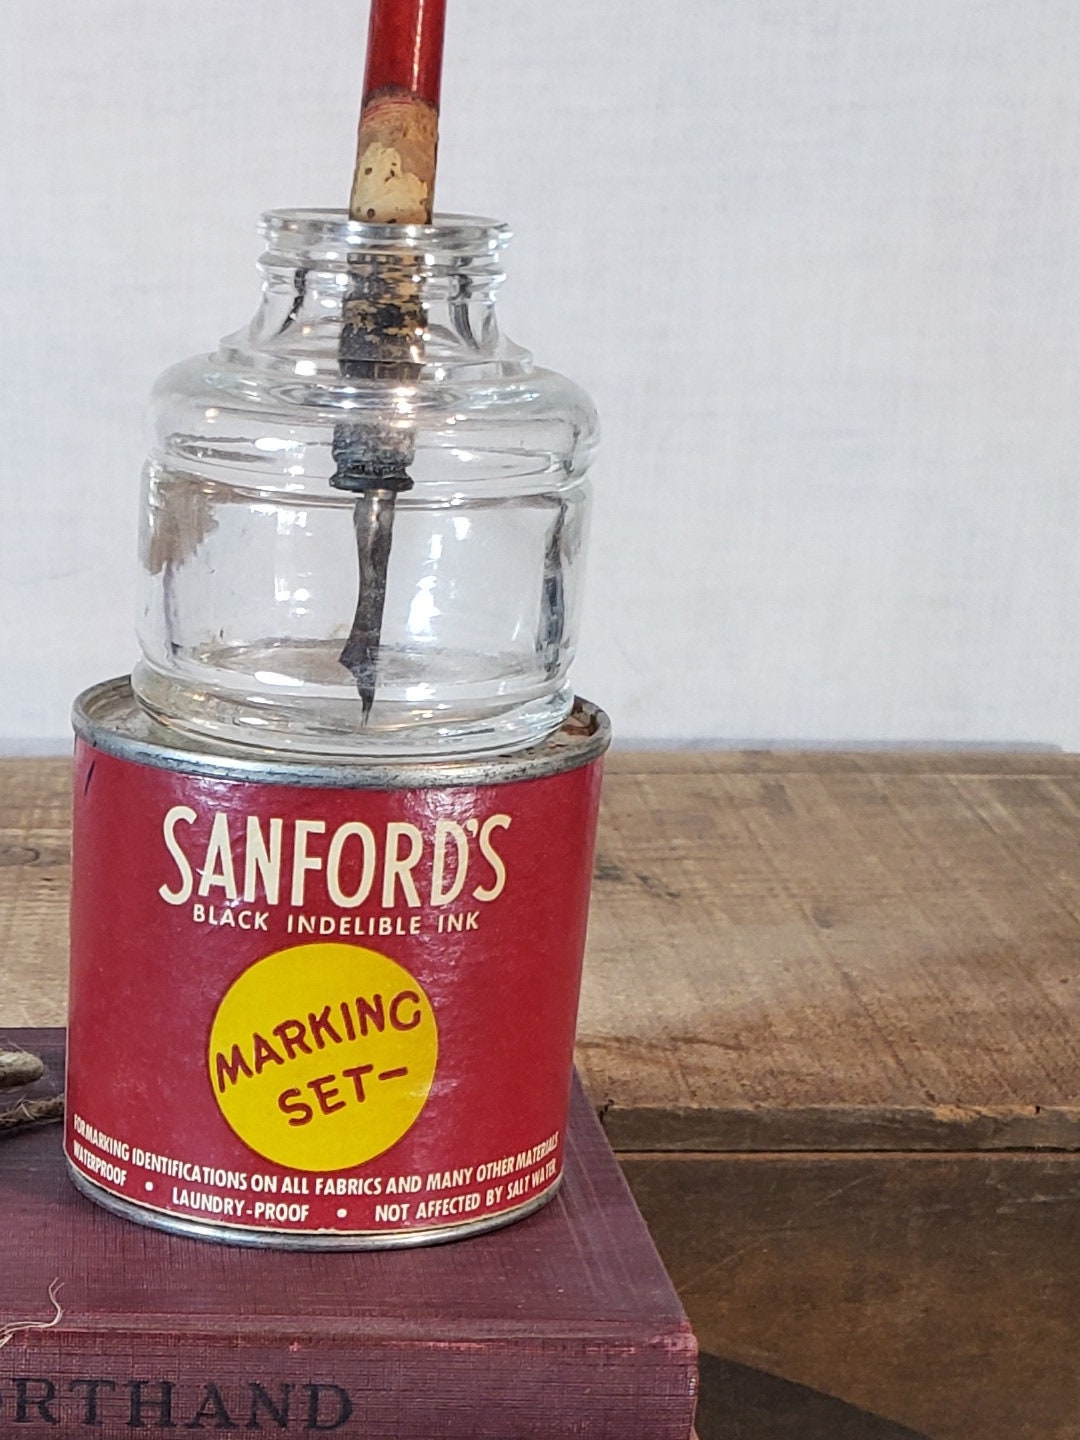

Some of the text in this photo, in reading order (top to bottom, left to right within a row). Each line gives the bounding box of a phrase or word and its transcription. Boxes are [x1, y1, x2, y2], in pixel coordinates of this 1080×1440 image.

[159, 805, 512, 908] SANFORD'S
[192, 903, 480, 936] BLACK INDELIBLE INK
[216, 990, 421, 1093] MARKING
[73, 1139, 557, 1222] WATERPROOF LAUNDRY-PROOF NOT AFFECTED BY SALT WATER
[132, 1147, 247, 1191] IDENTIFICATIONS
[251, 1174, 277, 1193] ON
[281, 1176, 309, 1194] ALL
[315, 1177, 381, 1196] FABRICS
[385, 1175, 421, 1194] AND
[426, 1167, 472, 1191] MANY
[476, 1157, 514, 1182] OTHER
[515, 1131, 559, 1171] MATERIALS
